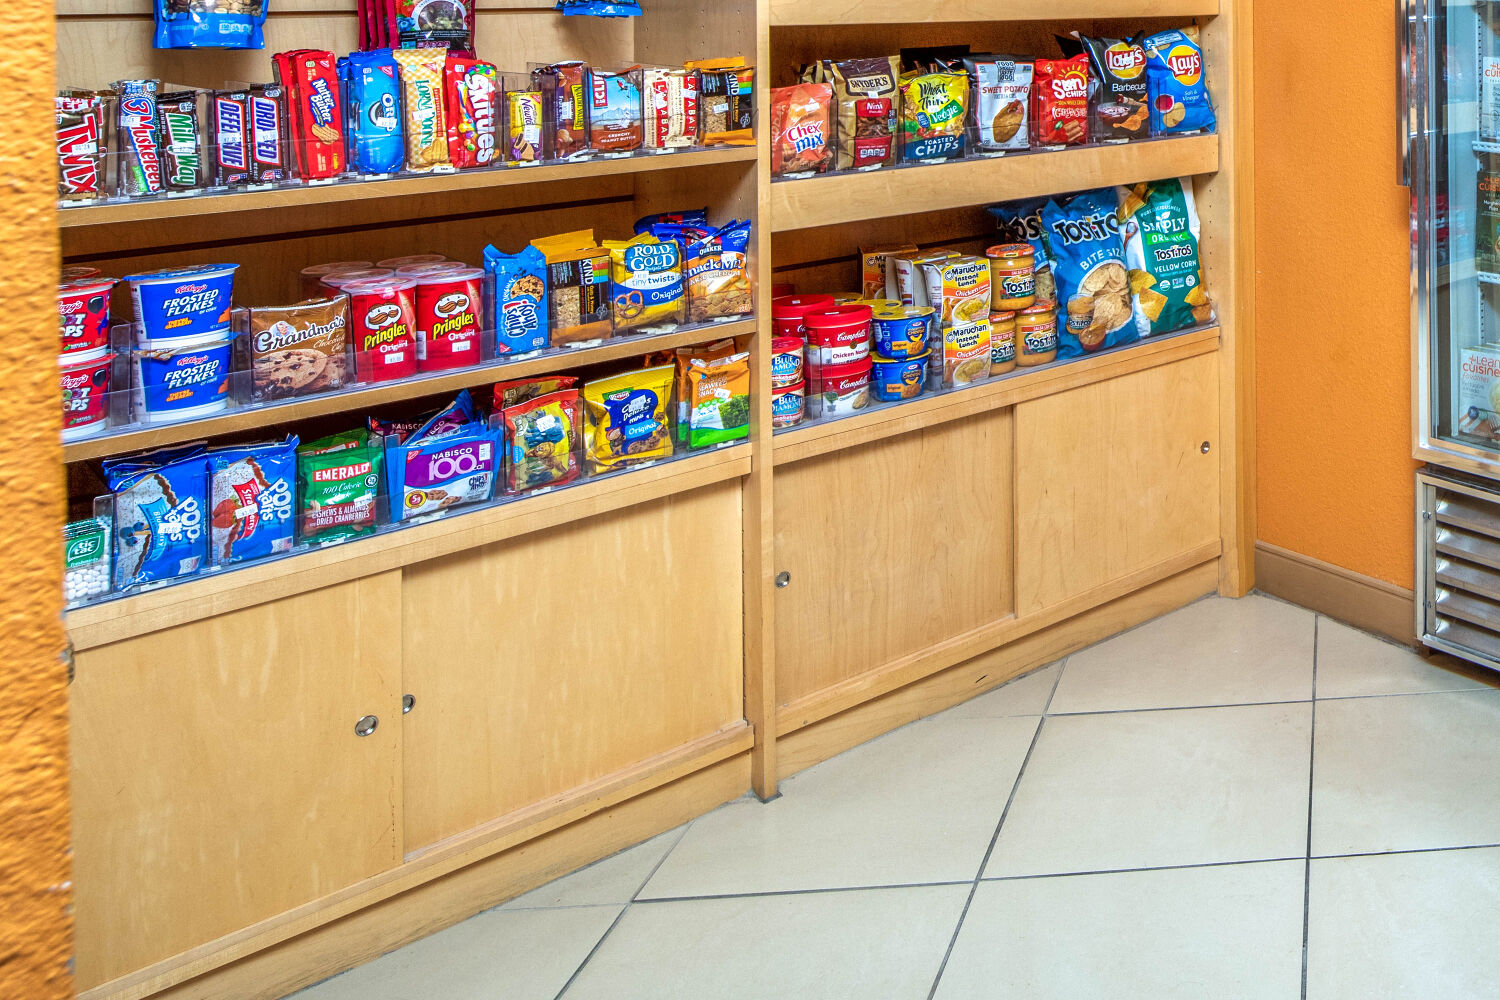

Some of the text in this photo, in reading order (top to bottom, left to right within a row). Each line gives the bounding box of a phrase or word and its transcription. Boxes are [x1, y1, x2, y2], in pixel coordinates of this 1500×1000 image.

[1172, 54, 1200, 75] Lay's
[850, 77, 888, 89] SNYDER'S
[1112, 83, 1146, 92] Barbecue
[932, 105, 958, 123] Veggie
[787, 121, 821, 143] Chex
[924, 136, 955, 146] TOASTED
[57, 114, 97, 193] TWIX
[131, 116, 160, 191] Musketeers
[915, 142, 959, 156] CHIPS
[1054, 214, 1119, 245] TOSTITO
[634, 245, 669, 257] ROLD
[1155, 245, 1192, 261] TOSTITOS
[631, 253, 675, 271] GOLD
[1080, 253, 1104, 270] BITE
[1154, 260, 1197, 273] YELLOW CORN
[952, 263, 987, 276] Maruchan
[648, 275, 674, 283] twists
[955, 272, 980, 283] Instant
[958, 278, 977, 287] Lunch
[652, 283, 683, 300] Original
[955, 288, 978, 298] Chicken
[163, 289, 219, 309] FROSTED
[164, 299, 215, 317] FLAKES
[253, 305, 348, 354] Grandma's
[432, 311, 475, 340] Pringles
[953, 324, 988, 337] Maruchan
[364, 322, 408, 352] Pringles
[959, 340, 978, 349] Lunch
[775, 356, 796, 365] BLUE
[832, 351, 854, 360] Chicken
[956, 350, 978, 359] Chicken
[164, 359, 220, 382] FROSTED
[167, 370, 215, 389] FLAKES
[778, 396, 797, 405] BLUE
[629, 422, 656, 435] Original
[431, 448, 473, 460] NABISCO
[315, 463, 371, 481] EMERALD
[74, 545, 93, 555] tac
[77, 540, 94, 549] tic
